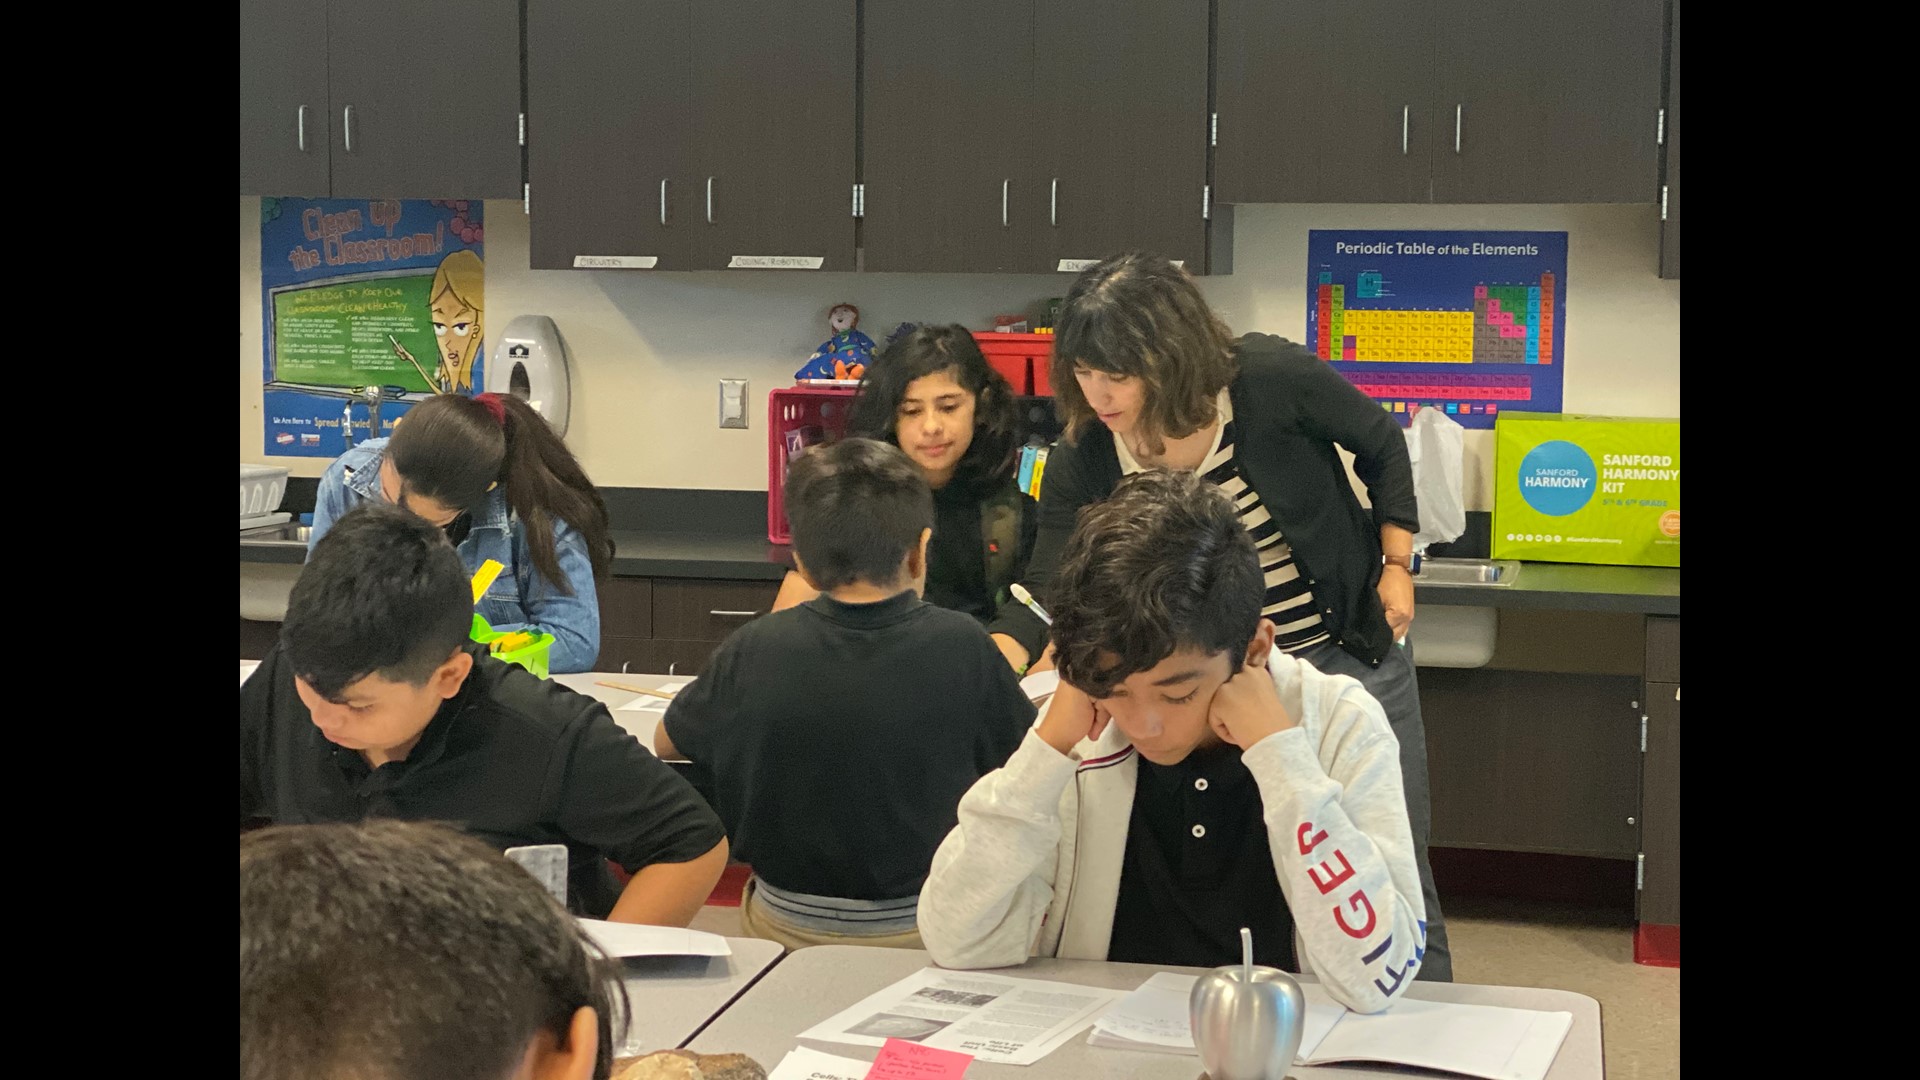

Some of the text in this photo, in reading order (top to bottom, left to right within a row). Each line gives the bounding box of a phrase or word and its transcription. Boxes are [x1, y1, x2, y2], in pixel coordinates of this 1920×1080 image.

[302, 200, 401, 241] Clean up
[289, 221, 444, 272] the Classroom!
[1336, 241, 1539, 256] Periodic Table of the Elements
[1366, 278, 1374, 286] H
[314, 417, 339, 429] Spread
[1603, 454, 1672, 467] SANFORD
[1603, 468, 1679, 481] HARMONY
[1525, 477, 1588, 488] HARMONY
[1603, 482, 1625, 493] KIT
